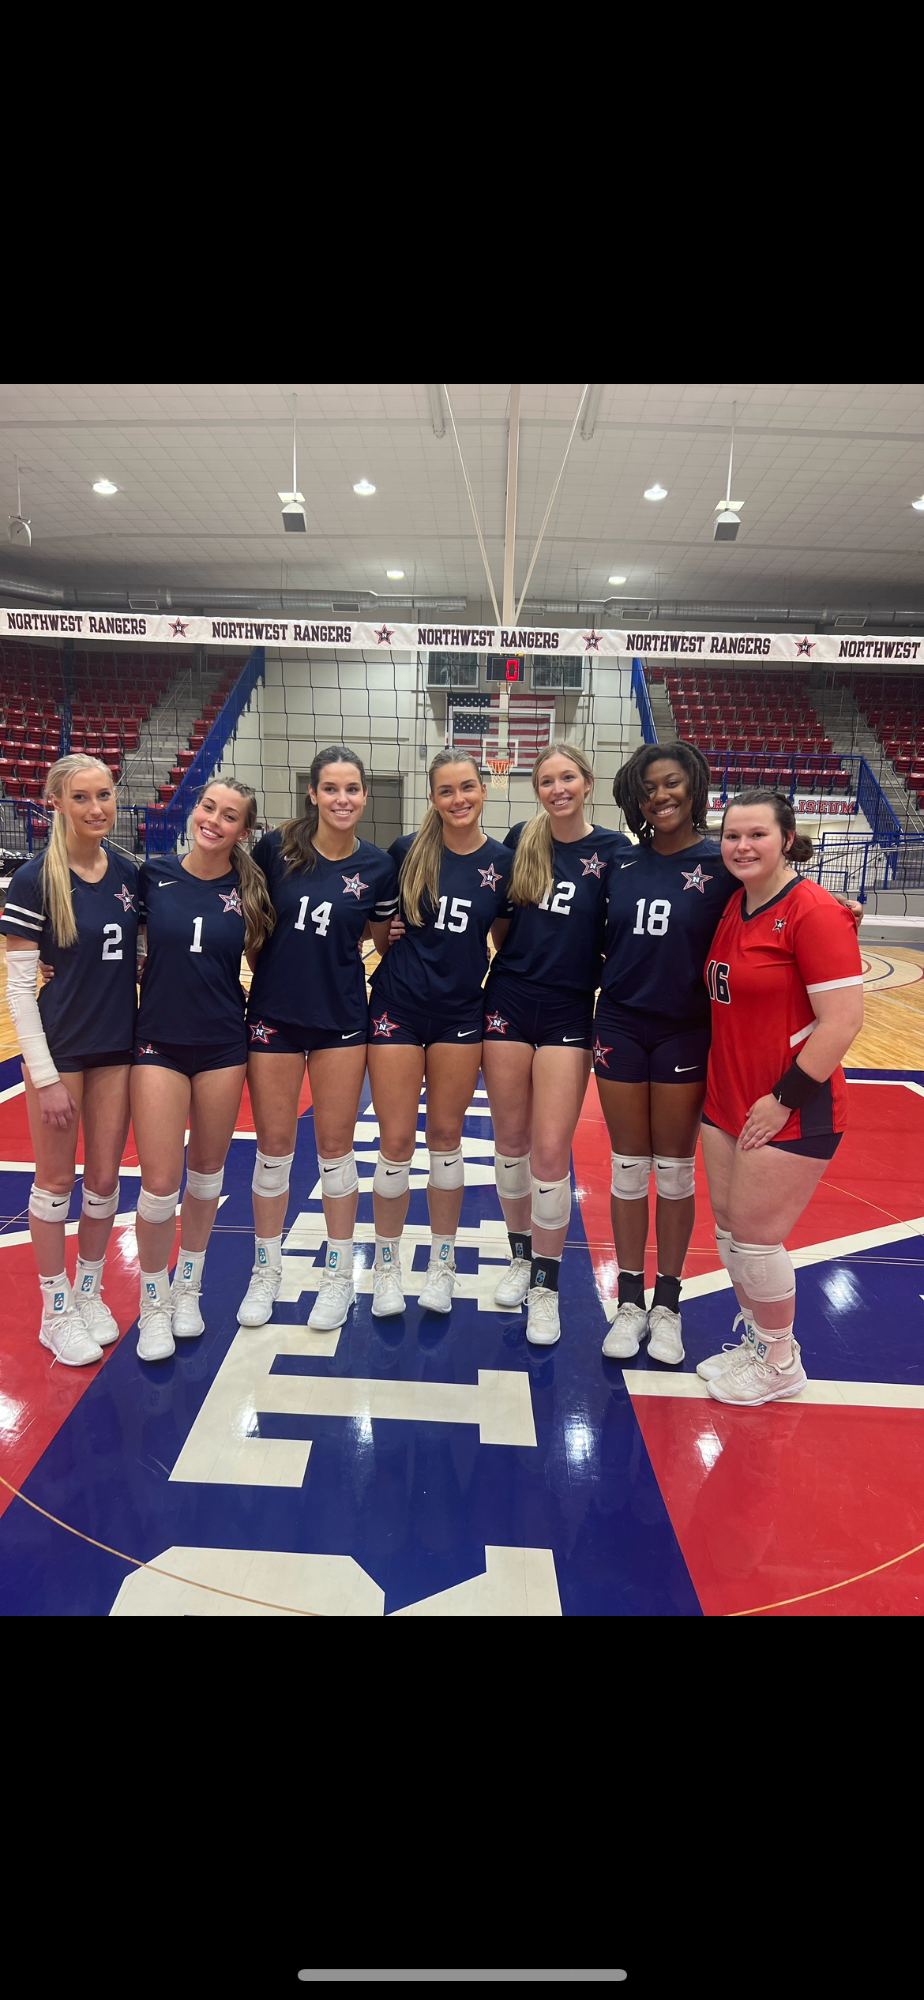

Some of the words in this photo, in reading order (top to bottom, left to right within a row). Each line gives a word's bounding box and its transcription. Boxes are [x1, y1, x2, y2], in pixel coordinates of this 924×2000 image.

[7, 612, 83, 633] NORTHWEST
[89, 616, 147, 636] RANGERS
[211, 621, 288, 642] NORTHWEST
[293, 624, 352, 643] RANGERS
[417, 628, 495, 648] NORTHWEST
[500, 630, 559, 650] RANGERS
[626, 633, 705, 654] NORTHWEST
[710, 635, 771, 656] RANGERS
[838, 640, 921, 660] NORTHWEST
[506, 660, 519, 681] 0
[793, 800, 857, 816] ISEUM
[294, 895, 333, 937] 14
[434, 895, 472, 934] 15
[632, 898, 672, 936] 18
[102, 923, 123, 960] 2
[189, 916, 203, 953] 1
[706, 960, 731, 1005] 16
